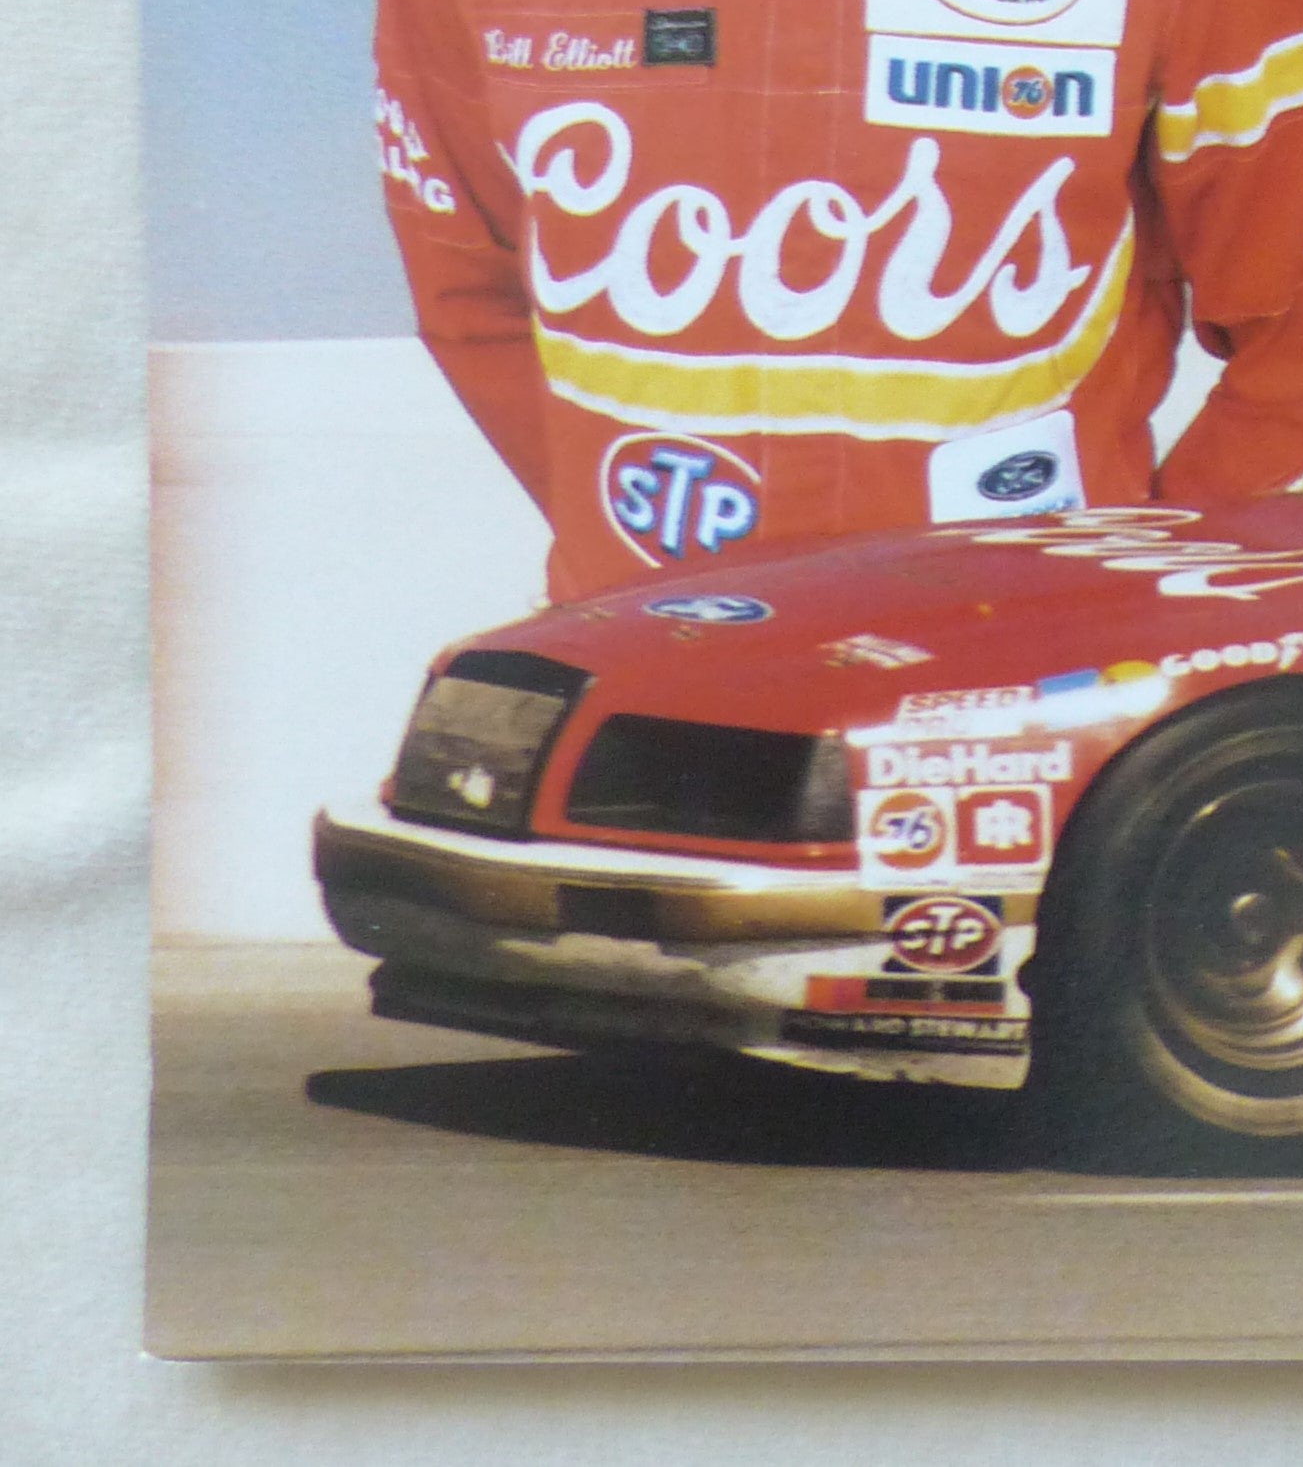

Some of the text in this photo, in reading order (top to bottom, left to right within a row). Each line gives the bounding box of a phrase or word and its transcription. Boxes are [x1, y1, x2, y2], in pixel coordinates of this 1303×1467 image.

[542, 29, 638, 72] Elliott
[495, 100, 1093, 341] Coors
[613, 444, 759, 560] STP
[867, 739, 1074, 786] DieHard
[900, 905, 985, 955] STP
